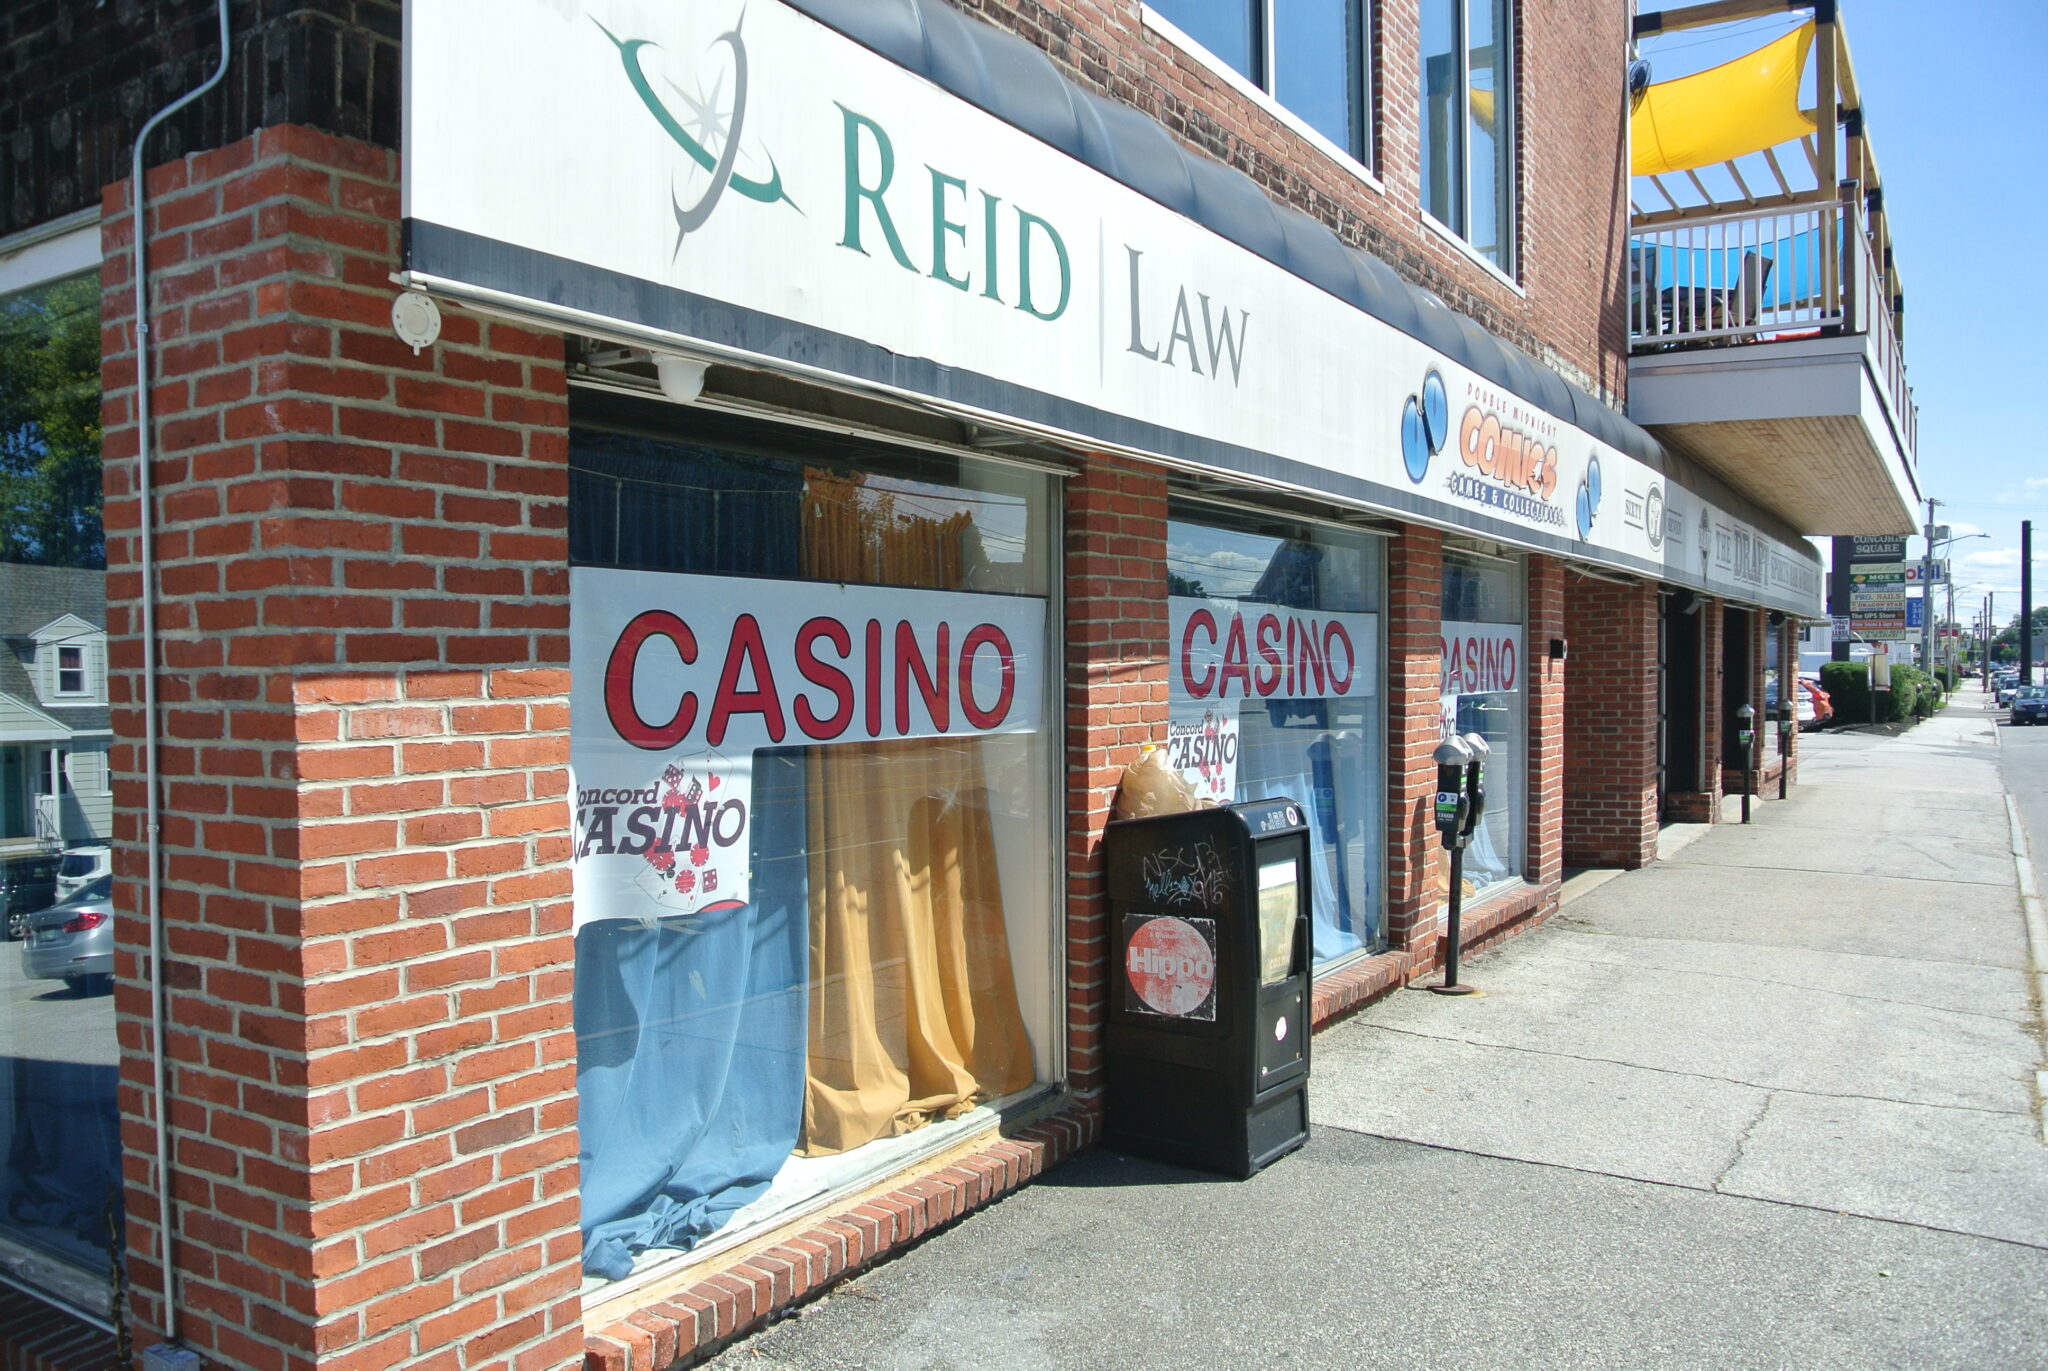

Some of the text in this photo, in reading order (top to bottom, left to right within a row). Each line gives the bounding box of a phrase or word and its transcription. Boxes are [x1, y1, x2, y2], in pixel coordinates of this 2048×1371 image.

[833, 99, 1250, 388] REID LAW
[1467, 382, 1557, 438] DOUBLE MIDNIGHT
[1459, 404, 1557, 502] COMICS
[1450, 471, 1486, 502] GAMES
[1492, 489, 1498, 504] &
[1625, 499, 1642, 521] SIXTY
[1715, 531, 1731, 564] THE
[1856, 544, 1900, 553] SQUARE
[1181, 608, 1355, 700] CASINO
[604, 609, 1015, 750] CASINO
[1170, 719, 1204, 737] Concord
[1168, 732, 1237, 770] CASINO
[576, 781, 660, 809] oncord
[1129, 946, 1212, 983] Hippo
